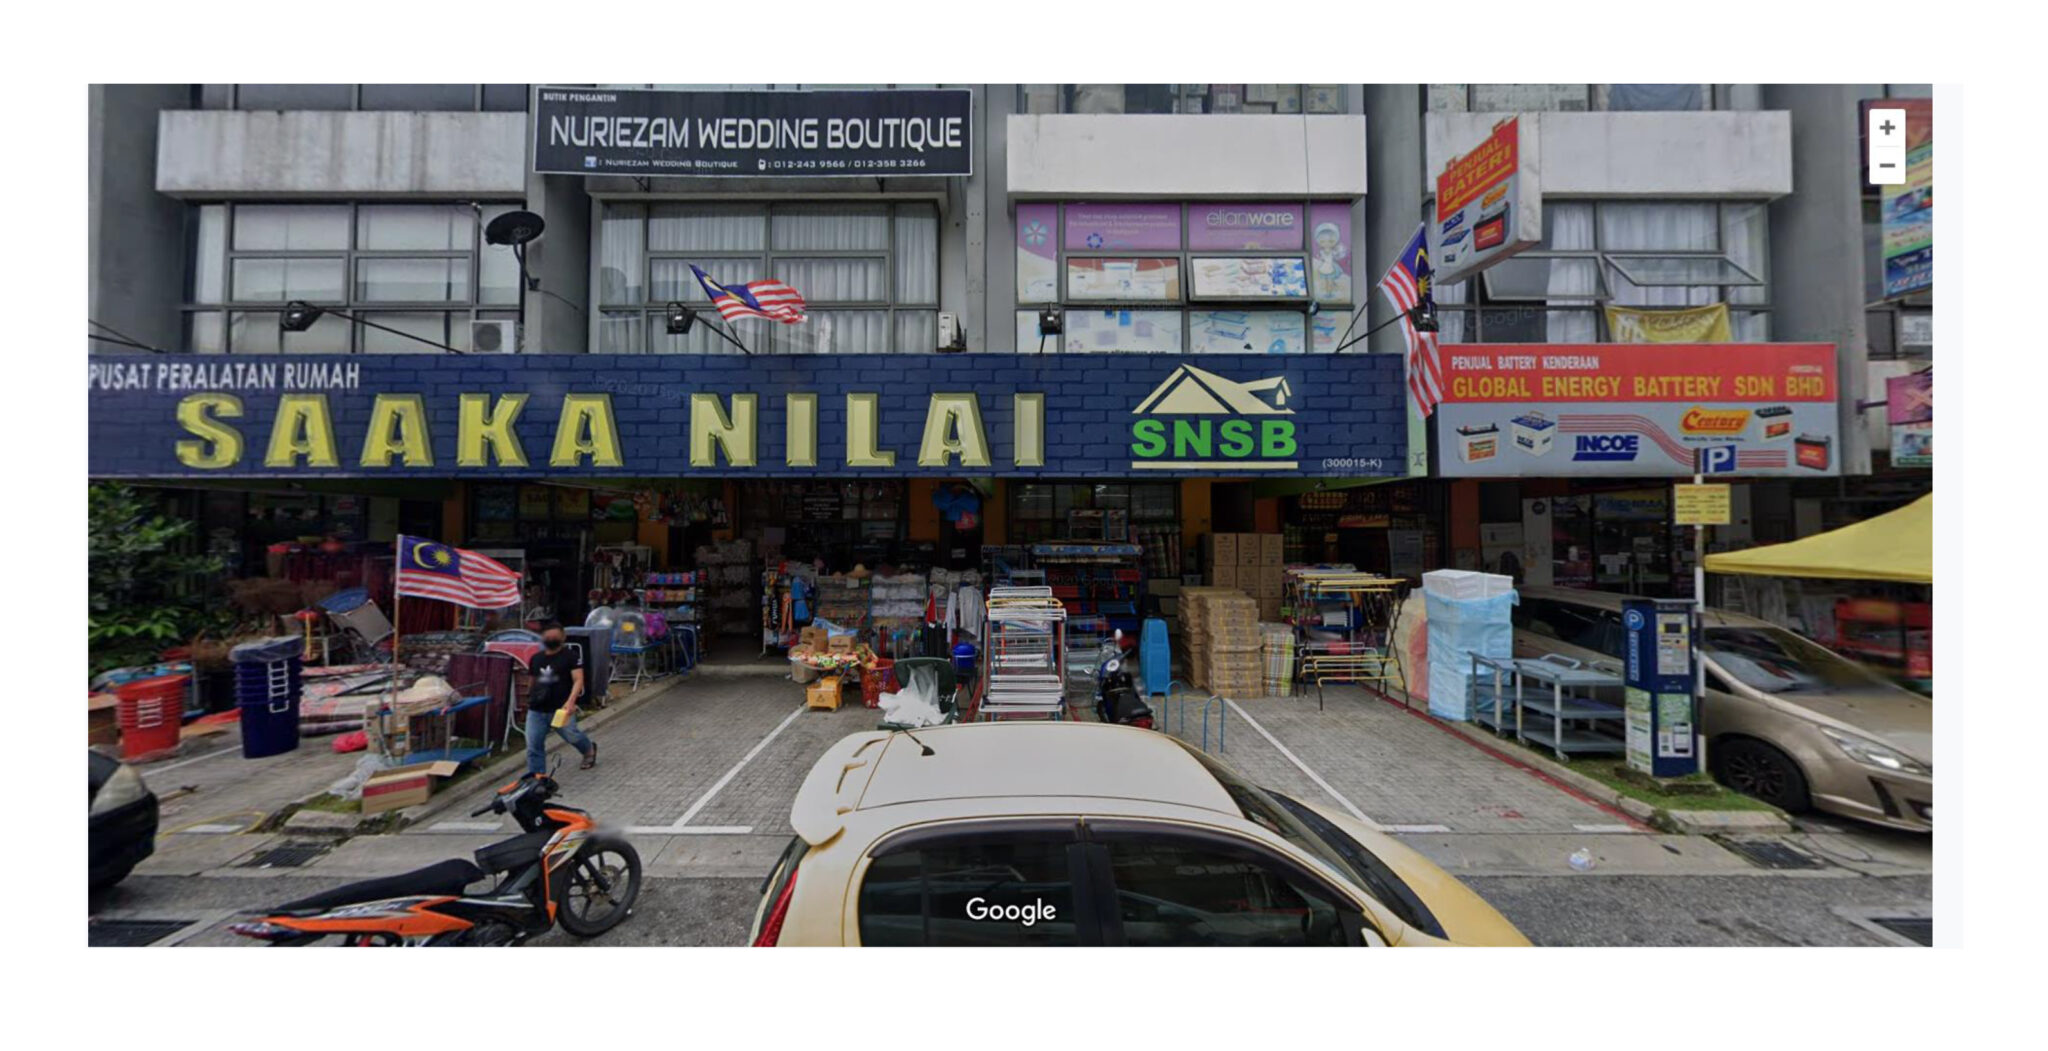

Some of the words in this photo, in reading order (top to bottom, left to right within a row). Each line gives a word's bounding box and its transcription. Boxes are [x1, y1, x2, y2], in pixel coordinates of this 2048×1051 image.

[543, 92, 568, 101] BUTIK
[569, 93, 617, 102] PENGANTIN
[550, 115, 689, 149] NURIEZAM
[698, 117, 819, 150] WEDDING
[827, 117, 963, 152] BOUTIQUE
[1443, 143, 1512, 202] BATERI
[1206, 208, 1294, 226] elianware
[1452, 356, 1492, 370] PENJUAL
[1498, 355, 1537, 370] BATTERY
[1543, 355, 1600, 370] KENDERAAN
[88, 363, 153, 390] PUSAT
[157, 363, 277, 390] PERALATAN
[284, 363, 360, 389] RUMAH
[1453, 376, 1532, 398] GLOBAL
[1542, 376, 1622, 398] ENERGY
[1633, 376, 1722, 397] BATTERY
[1734, 376, 1775, 397] SDN
[1786, 376, 1825, 397] BHD
[175, 392, 624, 469] SAAKA
[690, 392, 1045, 468] NILAI
[1131, 419, 1298, 458] SNSB
[1575, 435, 1639, 453] INCOE
[1322, 458, 1383, 469] (300015-K)
[1707, 446, 1730, 473] P
